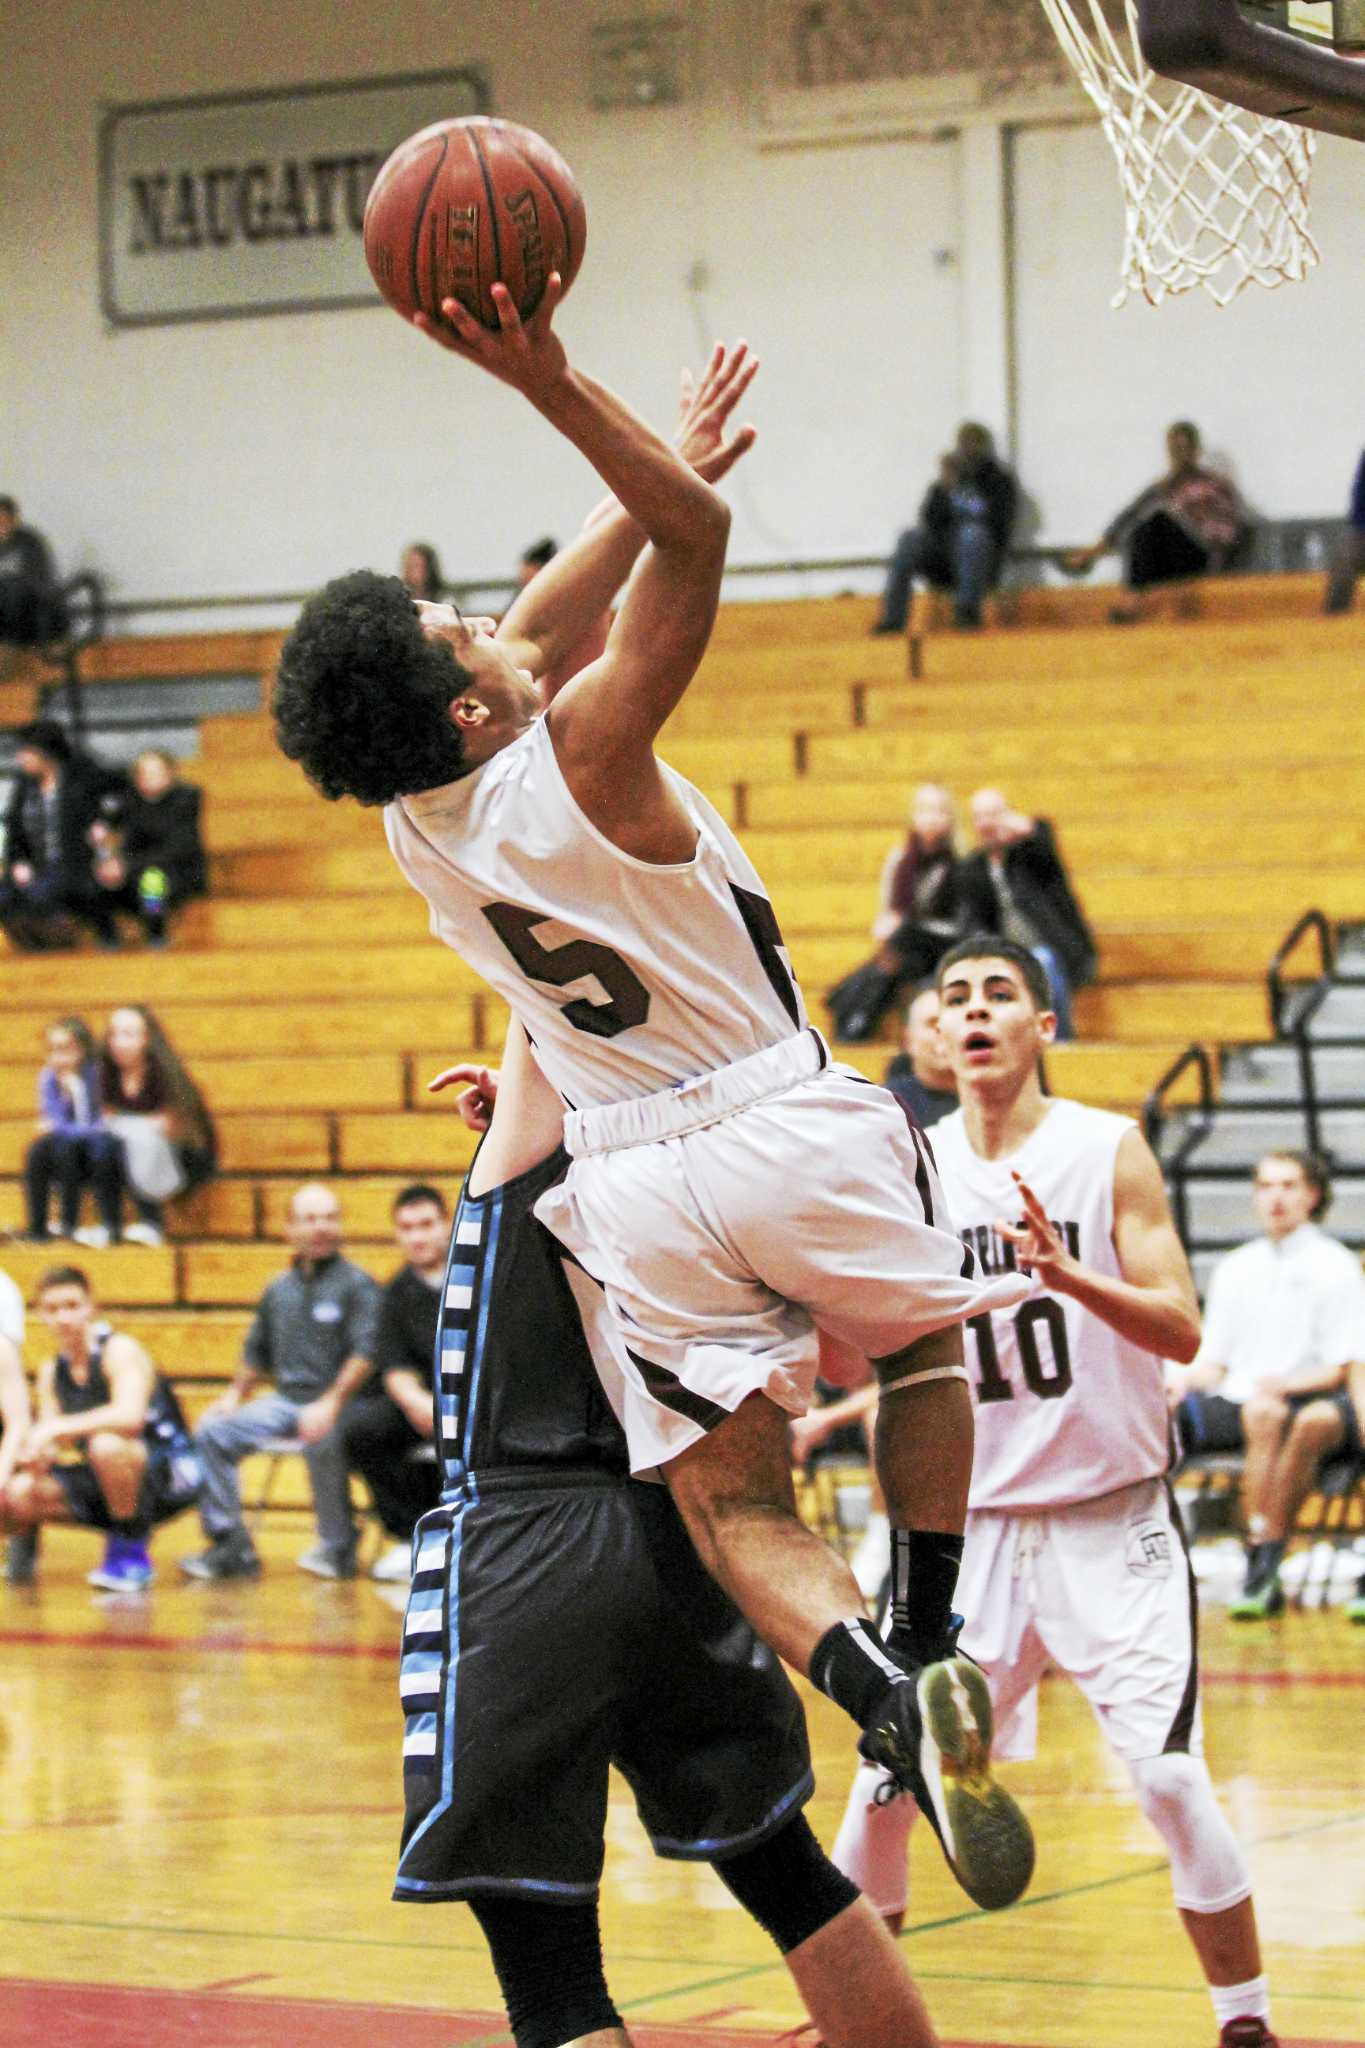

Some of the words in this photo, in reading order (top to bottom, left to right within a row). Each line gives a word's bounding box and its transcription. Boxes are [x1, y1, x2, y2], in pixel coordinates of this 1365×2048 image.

[130, 152, 376, 252] NAUGATU
[480, 901, 651, 1039] 5
[965, 1297, 1073, 1404] 10
